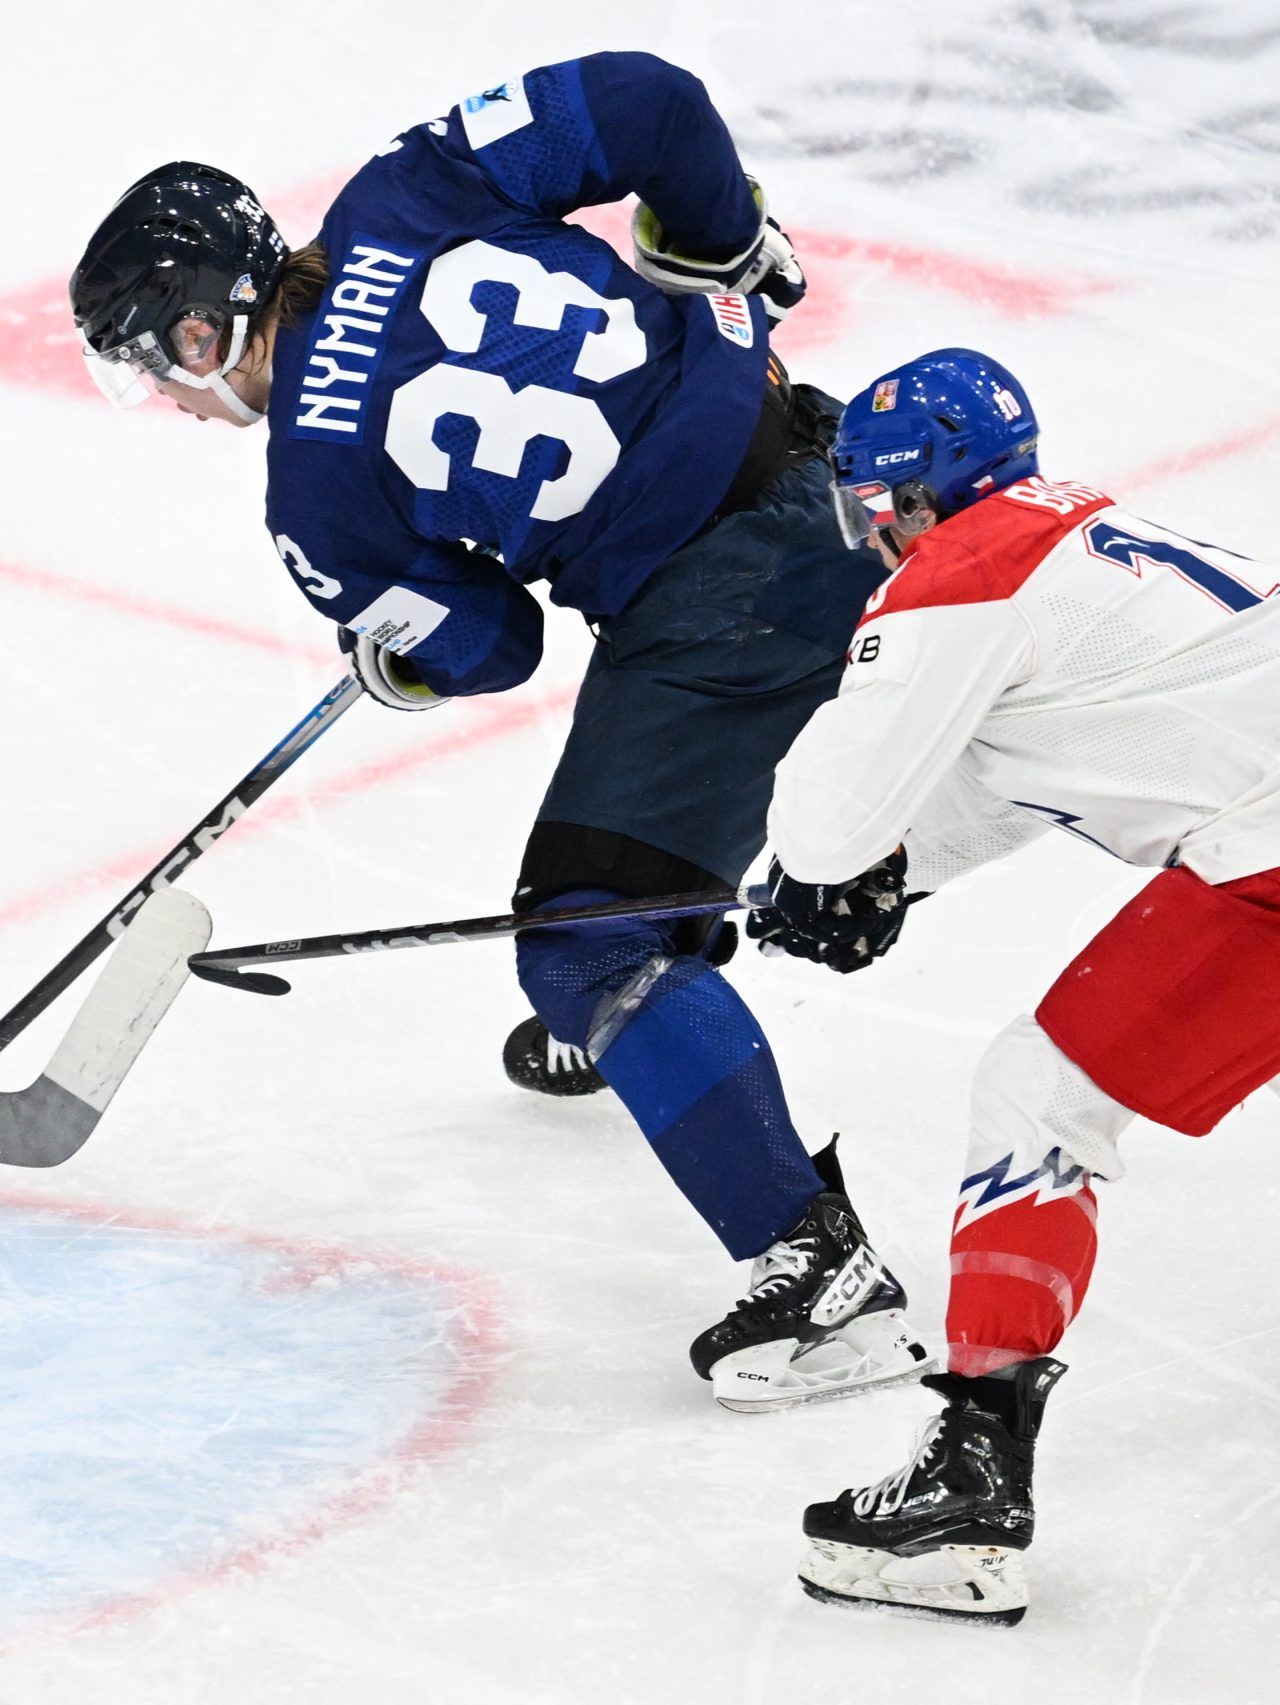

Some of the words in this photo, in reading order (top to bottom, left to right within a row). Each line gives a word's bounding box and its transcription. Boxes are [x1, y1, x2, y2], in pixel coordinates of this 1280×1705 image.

[296, 246, 414, 433] NYMAN
[384, 239, 647, 521] 33
[875, 449, 919, 466] CCM
[736, 1371, 770, 1383] CCM
